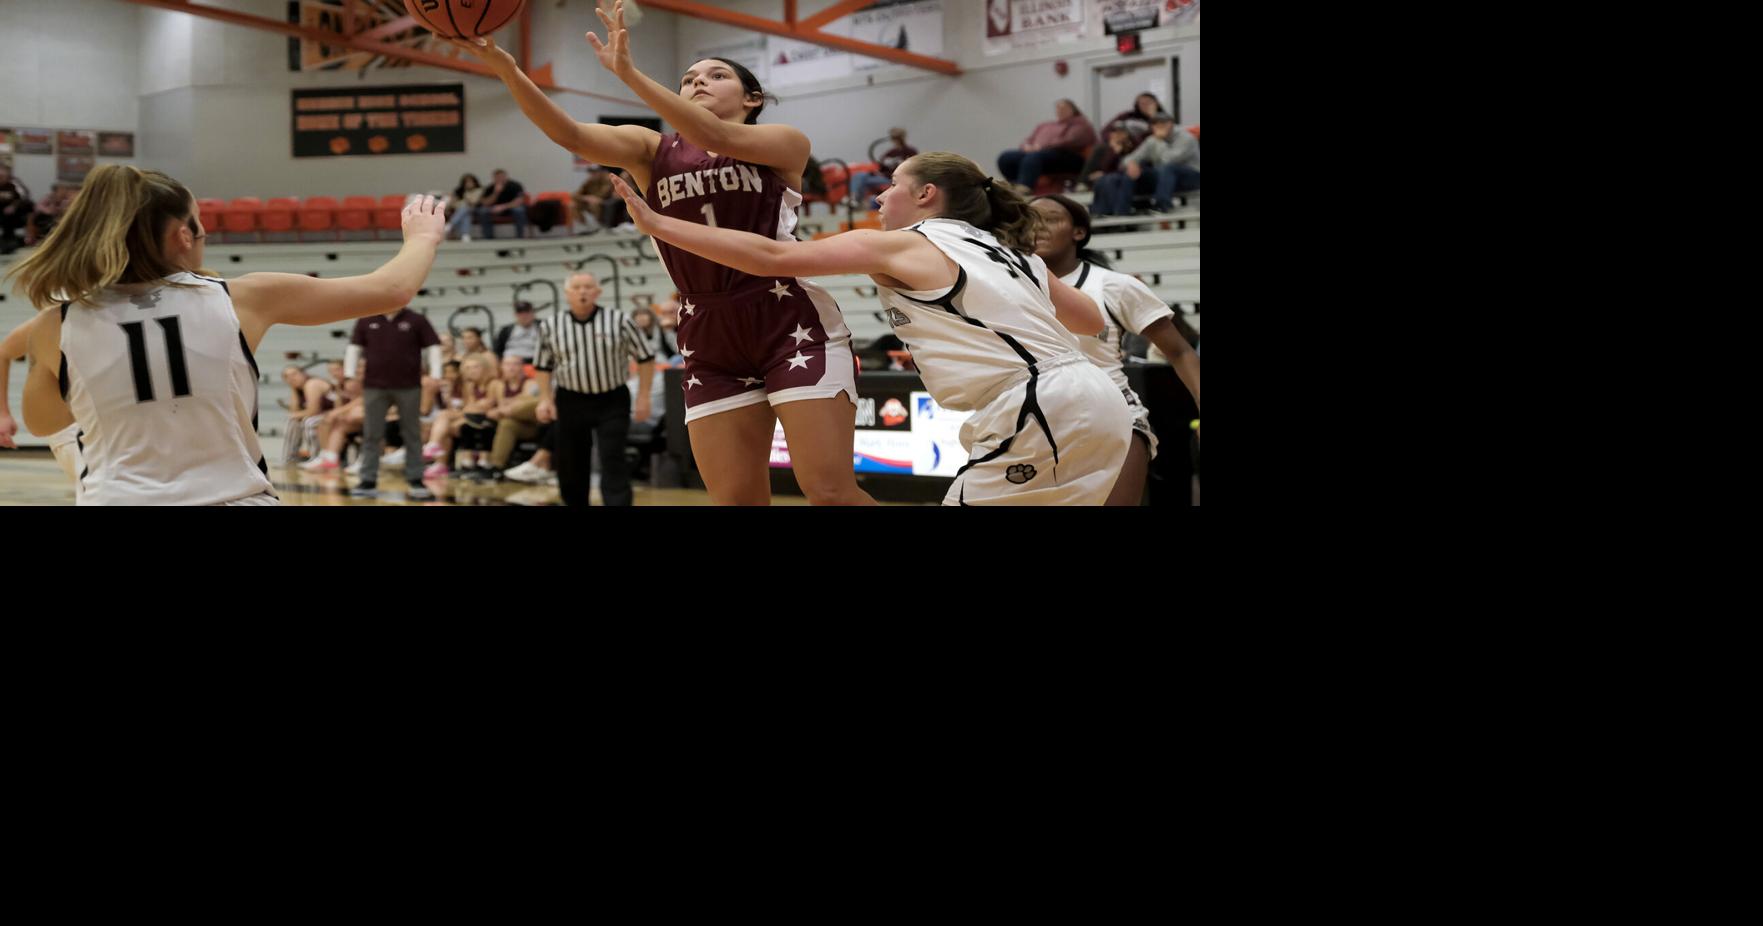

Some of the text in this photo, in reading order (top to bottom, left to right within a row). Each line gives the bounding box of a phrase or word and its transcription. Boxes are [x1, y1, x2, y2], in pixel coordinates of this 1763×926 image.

[657, 164, 762, 208] BENTON
[701, 203, 718, 228] 1
[118, 314, 193, 404] 11
